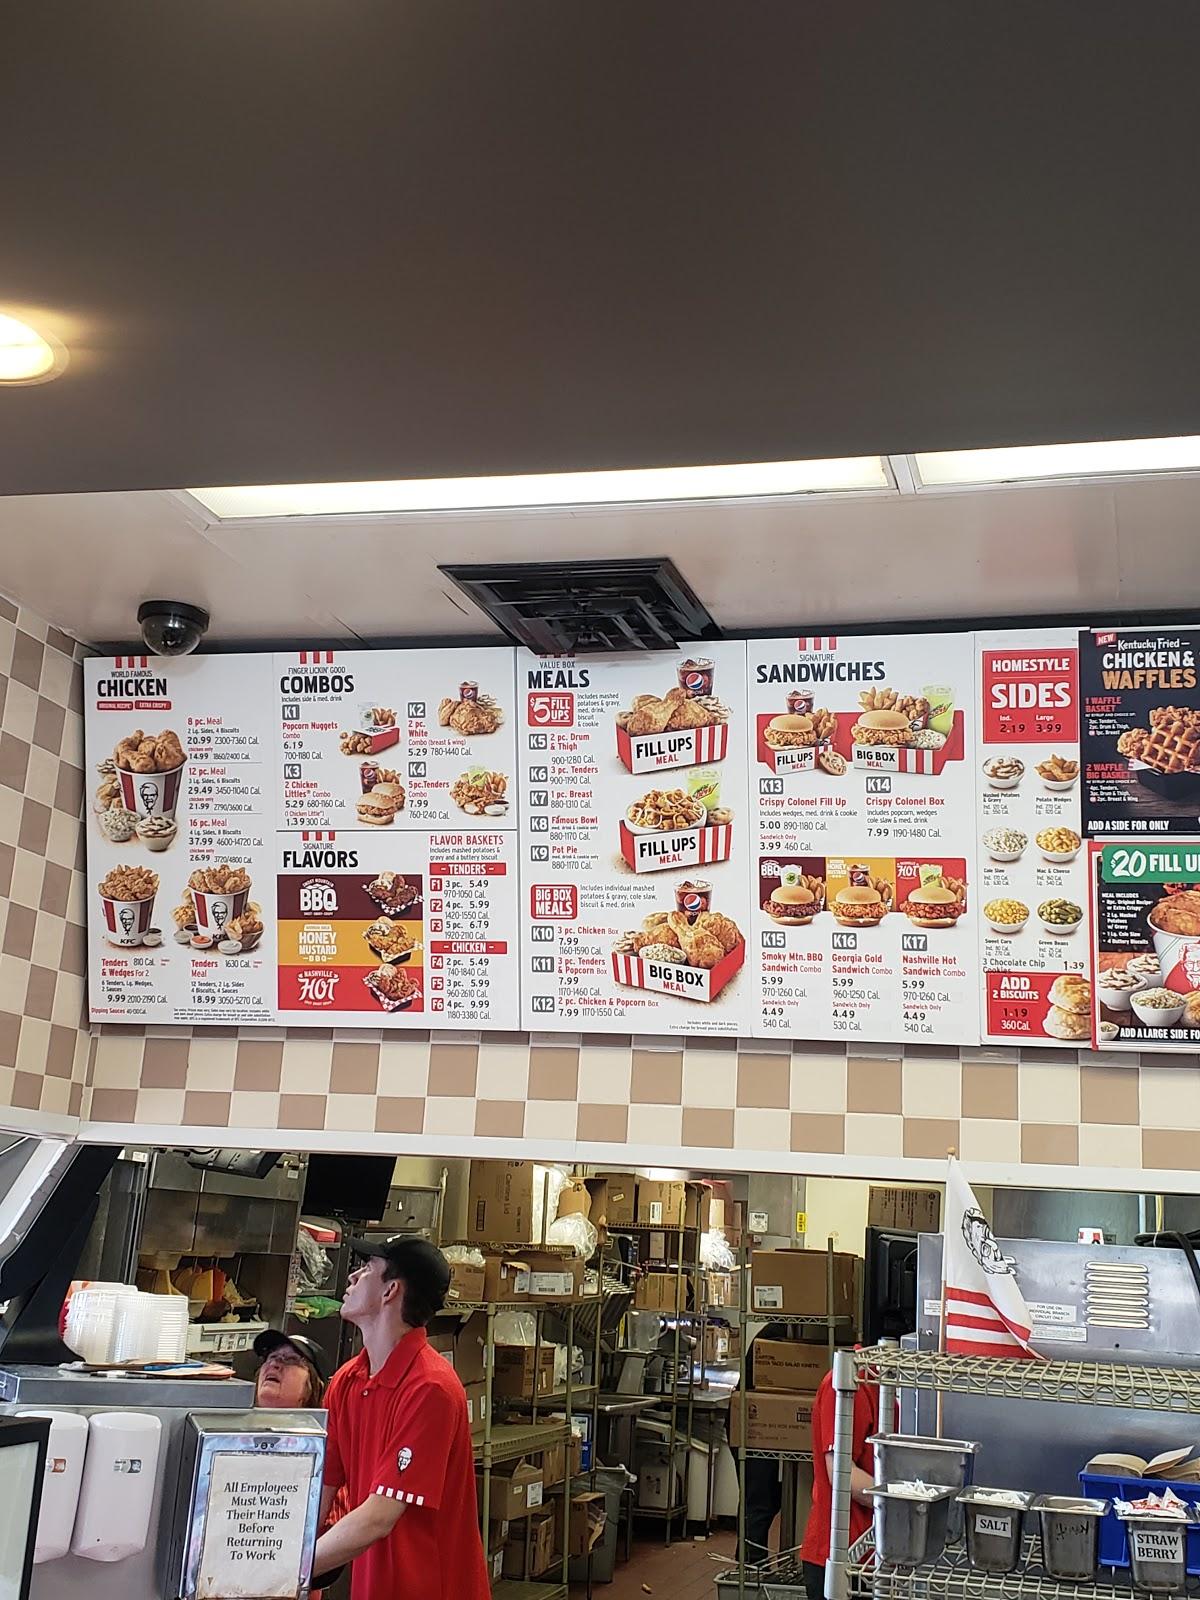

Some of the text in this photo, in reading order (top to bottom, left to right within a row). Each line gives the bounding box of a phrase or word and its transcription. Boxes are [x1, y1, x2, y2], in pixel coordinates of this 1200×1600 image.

[1098, 634, 1114, 644] NEW
[1118, 638, 1180, 651] Kentucky Fried
[1102, 651, 1195, 668] CHICKEN &
[992, 658, 1069, 672] HOMESTYLE
[757, 662, 885, 683] SANDWICHES
[280, 675, 354, 693] COMBOS
[528, 670, 590, 689] MEALS
[1102, 668, 1196, 690] WAFFLES
[97, 678, 167, 697] CHICKEN
[991, 682, 1071, 709] SIDES
[551, 699, 570, 709] FILL
[551, 710, 569, 720] UPS
[283, 722, 338, 730] Popcorn Nuggets
[1000, 724, 1061, 733] 2.19 3.99
[215, 737, 246, 745] 2300-7360
[284, 741, 303, 749] 6.19
[408, 748, 427, 756] 5.29
[636, 736, 693, 759] FILL UPS
[656, 755, 679, 765] MEAL
[777, 751, 813, 766] FILL UPS
[857, 751, 895, 762] BIG BOX
[761, 780, 782, 793] K13
[867, 779, 890, 791] K14
[285, 800, 304, 808] 5.29
[760, 798, 784, 807] Crispy
[788, 798, 817, 806] Colonel
[836, 798, 846, 807] Up
[866, 797, 944, 807] Crispy Colonel Box
[760, 821, 780, 829] 5.00
[1088, 820, 1169, 830] ADD SIDE FOR ONLY
[867, 828, 889, 836] 7.99
[430, 835, 504, 845] FLAVOR BASKETS
[640, 836, 696, 858] FILL UPS
[760, 842, 780, 850] 3.99
[283, 851, 358, 868] FLAVORS
[659, 854, 682, 864] MEAL
[1110, 850, 1200, 877] $20 FILL U
[448, 864, 486, 874] TENDERS
[470, 880, 488, 888] 5.49
[553, 889, 571, 900] BOX
[300, 889, 338, 911] BBQ
[470, 901, 490, 909] 5.99
[536, 901, 572, 915] MEALS
[470, 921, 489, 929] 6.79
[299, 932, 336, 944] HONEY
[533, 928, 553, 940] K10
[559, 938, 578, 946] 7.99
[763, 933, 784, 946] K15
[834, 935, 856, 948] K16
[904, 936, 926, 949] K17
[299, 945, 337, 954] MUSTARD
[452, 942, 486, 952] CHICKEN
[470, 958, 489, 966] 5.49
[762, 952, 823, 962] Smoky BBQ
[832, 954, 882, 963] Georgia Gold
[903, 956, 939, 964] Nashville
[762, 963, 798, 972] Sandwich
[832, 965, 870, 974] Sandwich
[1064, 961, 1084, 970] 1.39
[109, 969, 134, 977] Wedges
[566, 967, 594, 975] Popcorn
[650, 965, 704, 987] BIG BOX
[903, 967, 940, 976] Sandwich
[559, 977, 579, 985] 7.99
[663, 980, 686, 992] MEAL
[761, 977, 783, 985] 5.99
[832, 978, 854, 986] 5.99
[902, 981, 924, 989] 5.99
[1001, 976, 1030, 990] ADD
[298, 978, 340, 1001] HOT
[762, 988, 792, 997] 970-1260
[834, 990, 865, 999] 960-1250
[192, 996, 250, 1004] 18.99 3050-5270
[904, 992, 935, 1000] 970-1260
[1001, 991, 1039, 1000] BISCUITS
[470, 1000, 490, 1008] 9.99
[533, 998, 553, 1010] K12
[616, 999, 646, 1007] Popcorn
[832, 1010, 855, 1018] 4.49
[904, 1012, 925, 1020] 4.49
[1120, 1028, 1136, 1038] ADD
[1170, 1029, 1188, 1039] SIDE
[224, 1482, 298, 1495] All Employees
[231, 1495, 288, 1506] Must Wash
[226, 1509, 290, 1520] Their Hands
[239, 1523, 274, 1533] Before
[980, 1518, 1009, 1531] SALT
[227, 1537, 283, 1550] Returning
[1137, 1533, 1178, 1546] STRAW
[230, 1550, 276, 1560] To Work
[1137, 1547, 1178, 1560] BERRY
